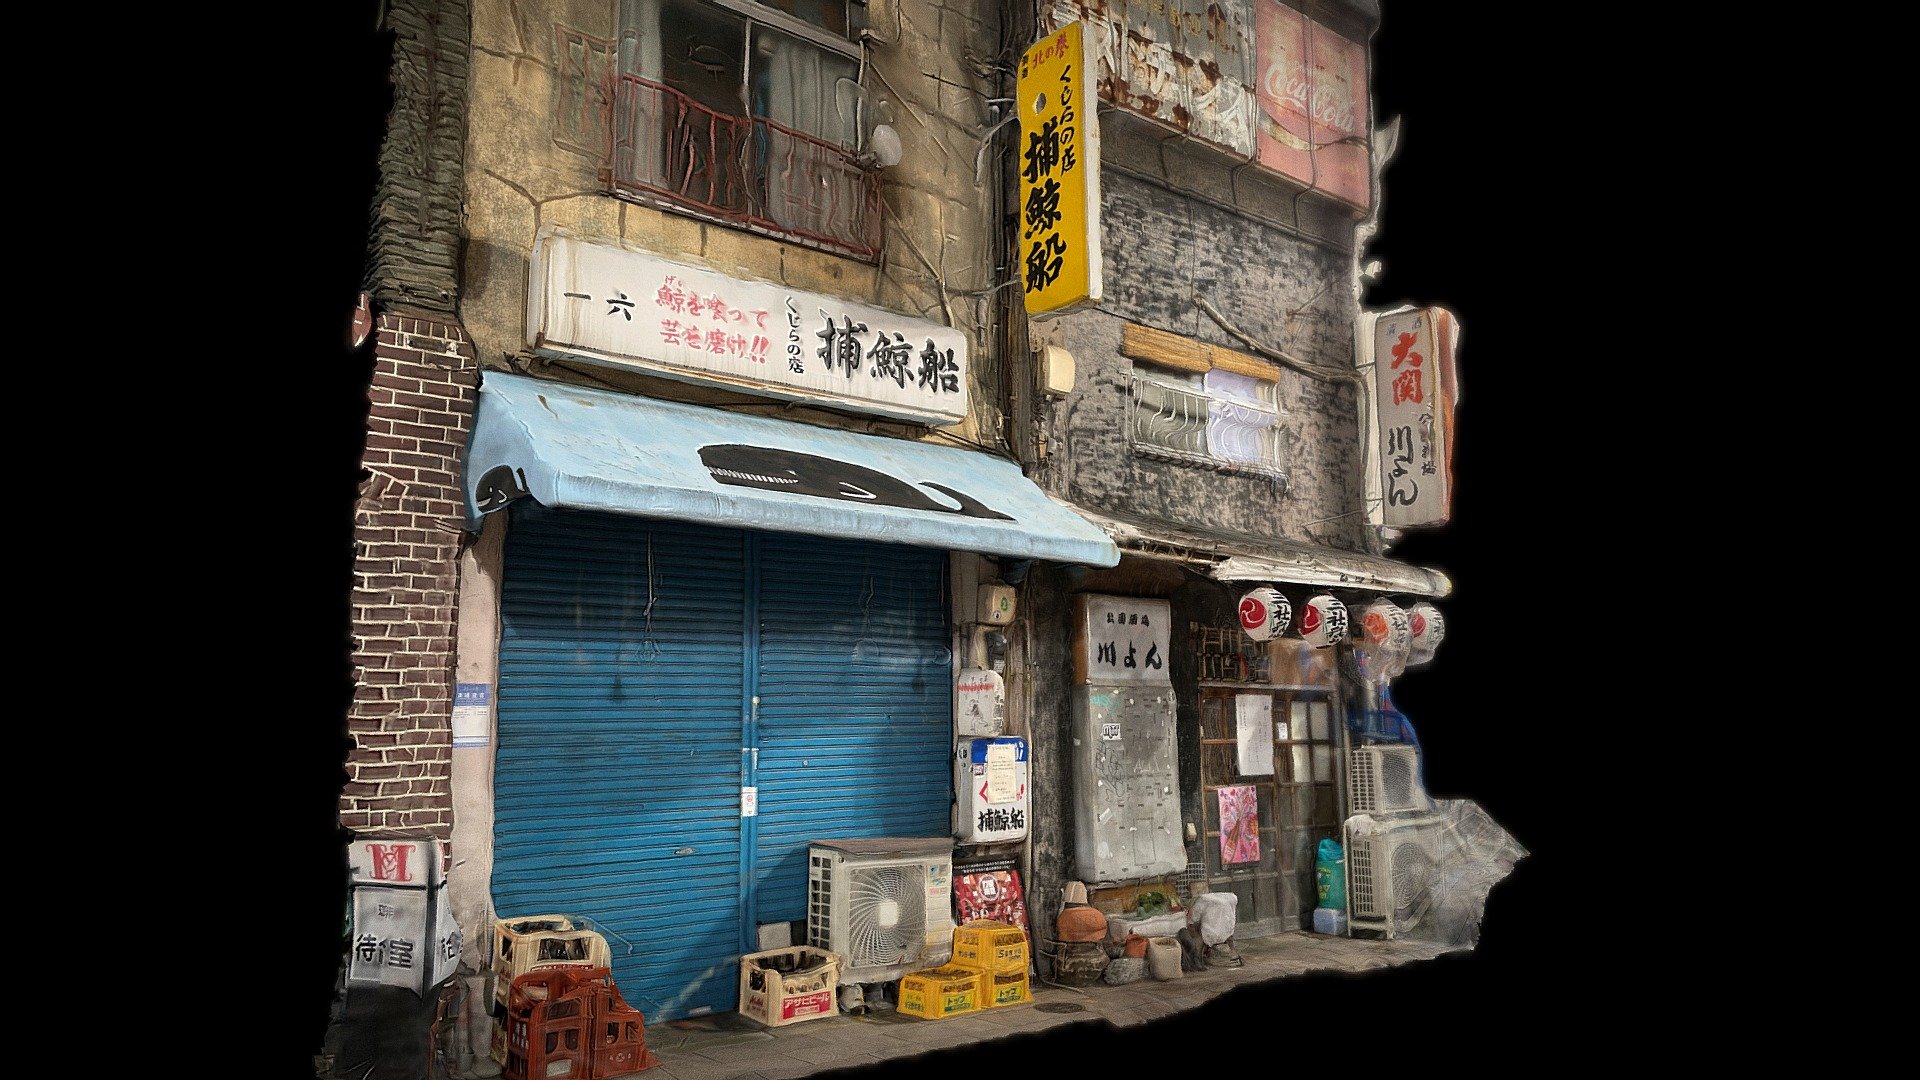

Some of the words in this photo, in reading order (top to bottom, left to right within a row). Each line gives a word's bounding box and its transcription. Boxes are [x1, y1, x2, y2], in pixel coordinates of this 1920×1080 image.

[1022, 116, 1067, 294] 捕鯨船
[785, 296, 804, 374] くじらの店
[816, 308, 960, 393] 捕鯨船
[1098, 641, 1162, 669] 川よん
[977, 807, 1024, 832] 捕鯨船
